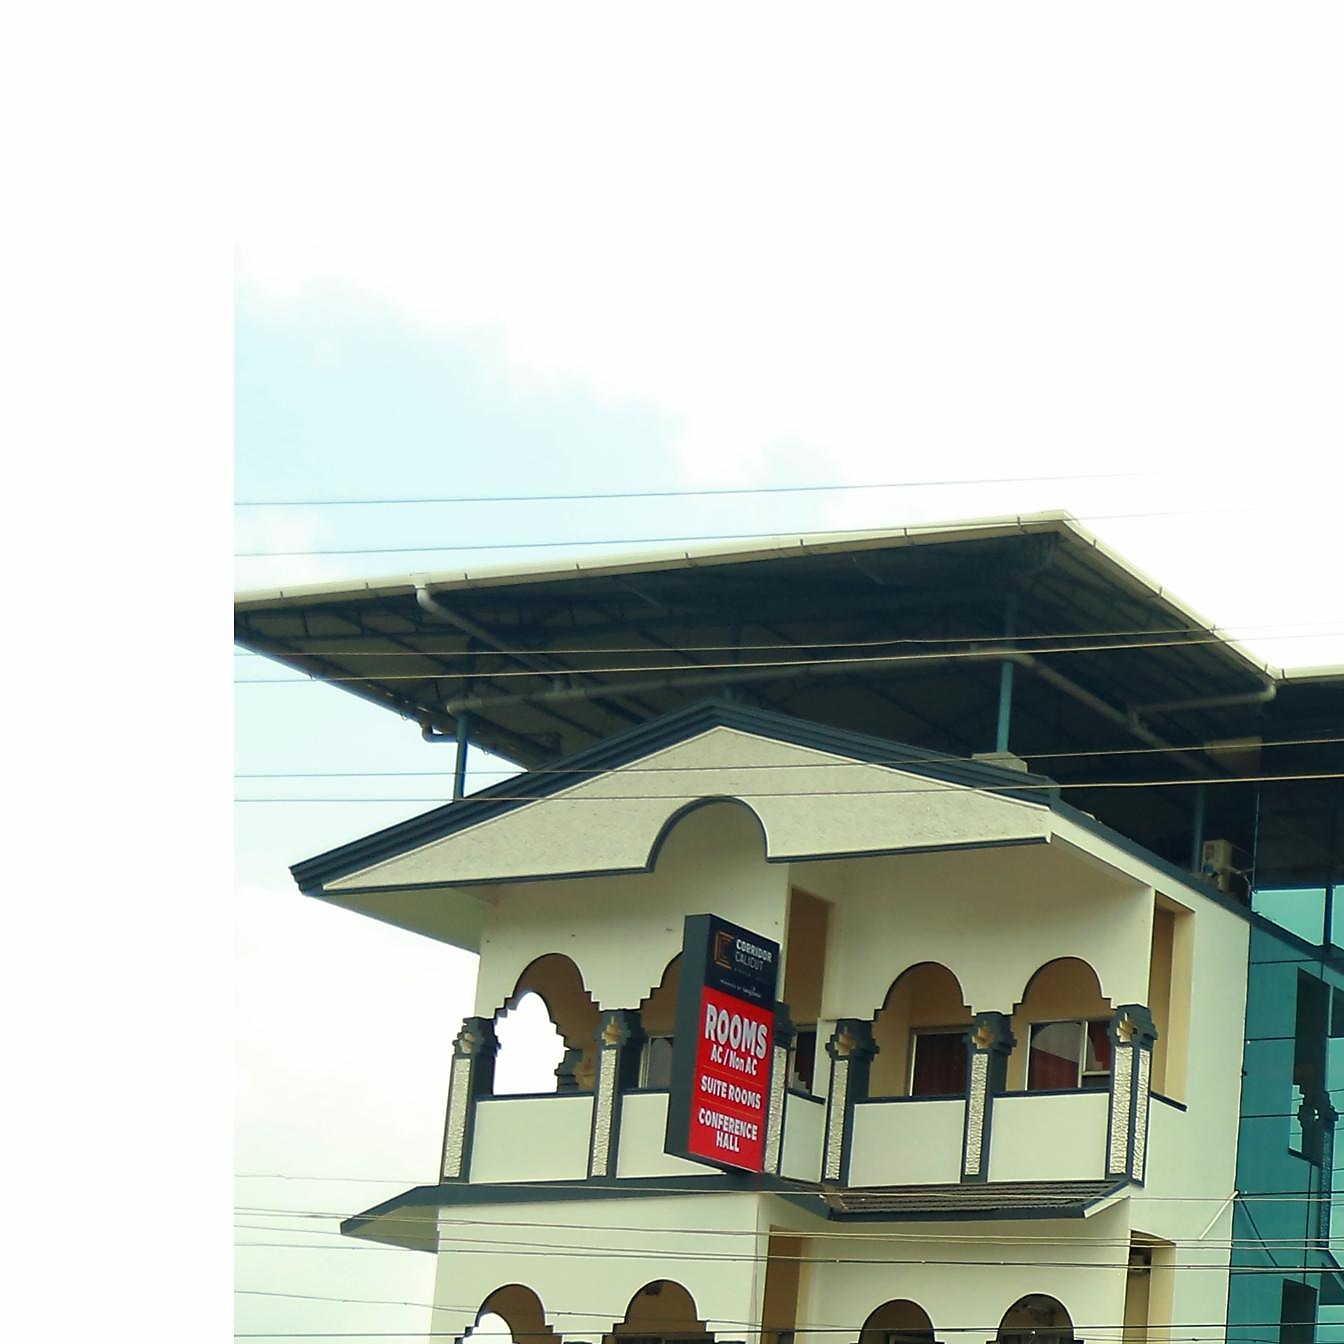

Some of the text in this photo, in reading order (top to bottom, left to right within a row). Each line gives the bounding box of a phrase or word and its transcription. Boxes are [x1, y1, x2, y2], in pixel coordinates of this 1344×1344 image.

[704, 1003, 768, 1059] ROOMS
[710, 1043, 723, 1063] AC
[729, 1054, 745, 1073] Non
[745, 1057, 758, 1076] AC
[701, 1075, 761, 1110] SUITE ROOMS
[698, 1108, 758, 1141] CONFERENCE
[715, 1131, 740, 1152] HALL
